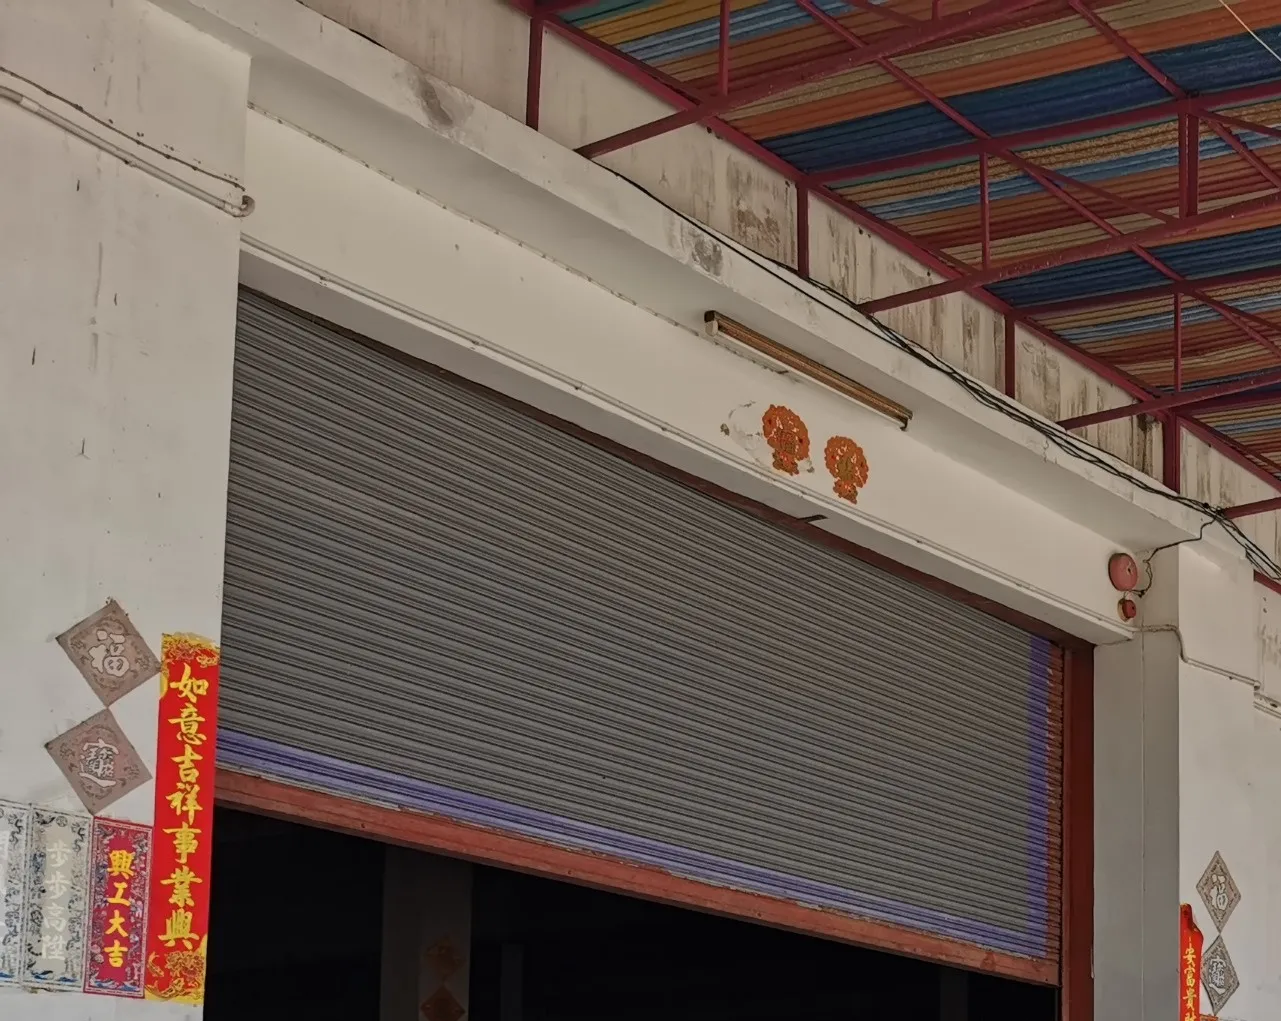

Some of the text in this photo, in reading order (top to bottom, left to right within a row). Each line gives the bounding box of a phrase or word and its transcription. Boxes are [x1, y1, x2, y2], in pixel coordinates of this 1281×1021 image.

[88, 628, 130, 677] 福
[157, 662, 209, 950] 如意吉祥事業興
[104, 849, 136, 968] 興工大吉
[1209, 873, 1229, 911] 福
